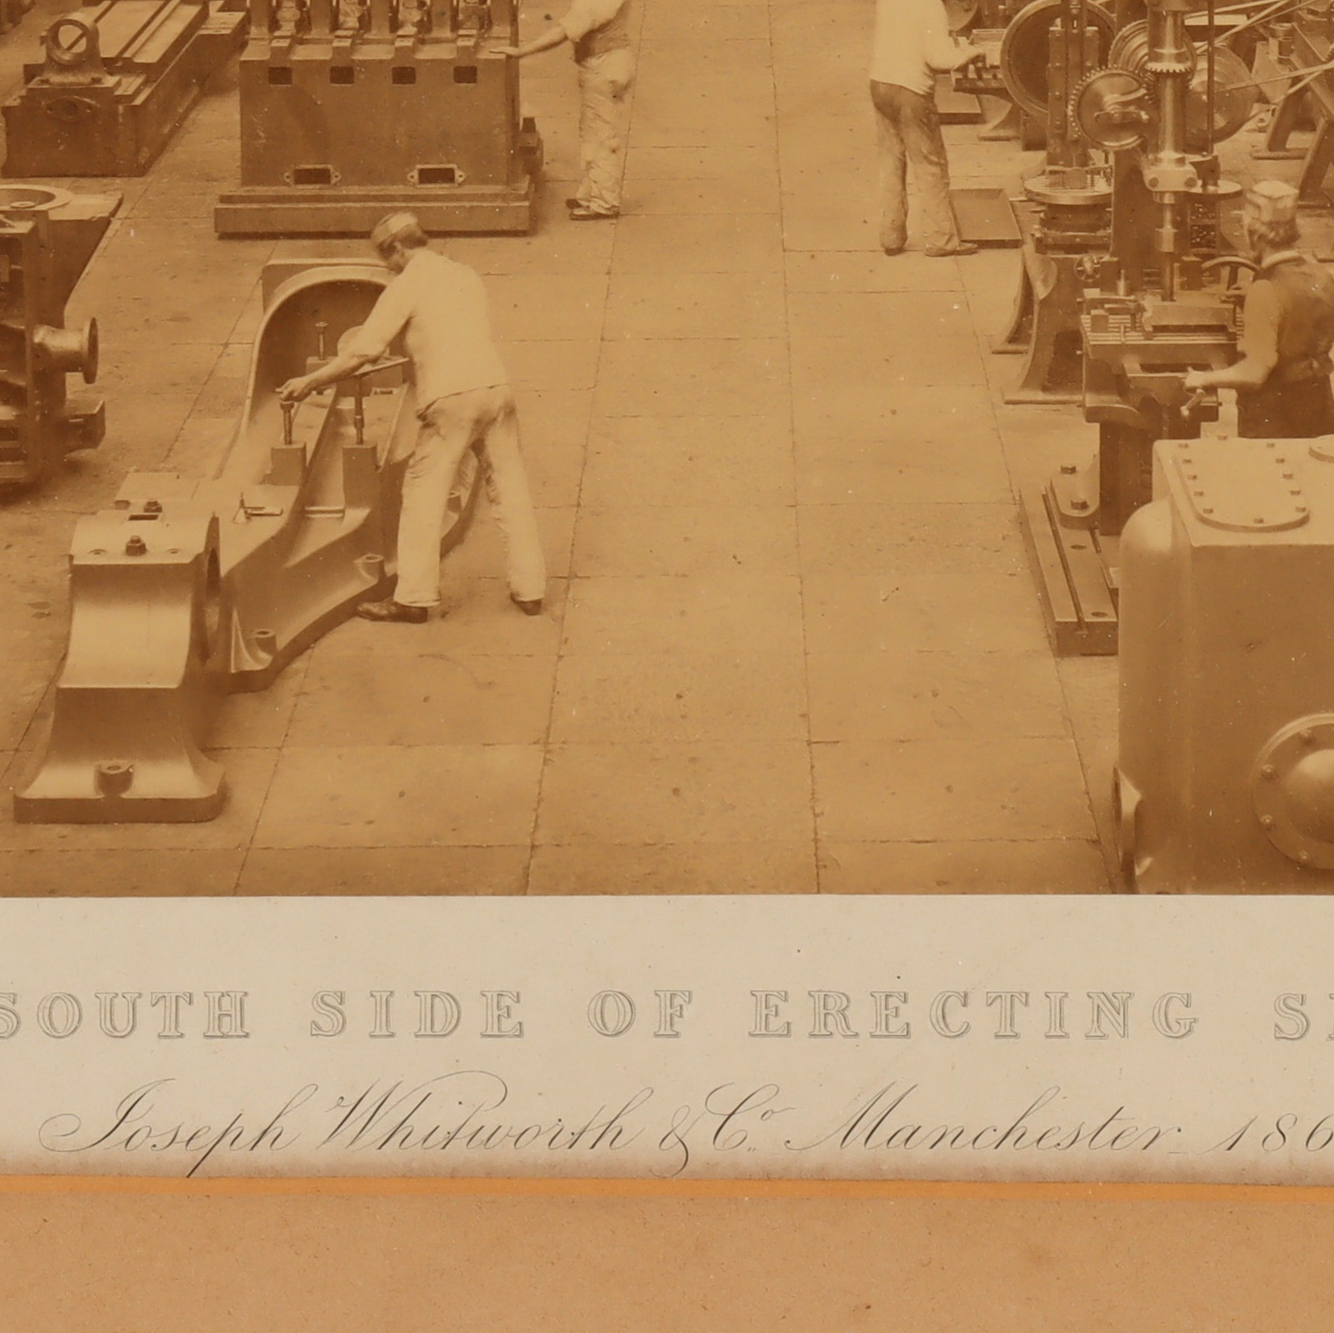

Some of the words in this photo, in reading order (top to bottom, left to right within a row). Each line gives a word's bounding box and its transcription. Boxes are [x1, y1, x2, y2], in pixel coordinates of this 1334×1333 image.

[310, 989, 525, 1040] SIDE
[587, 989, 692, 1039] OF
[748, 989, 1198, 1041] ERECTING
[38, 1077, 319, 1178] Joseph
[316, 1069, 654, 1152] Whitworth
[648, 1104, 701, 1178] &
